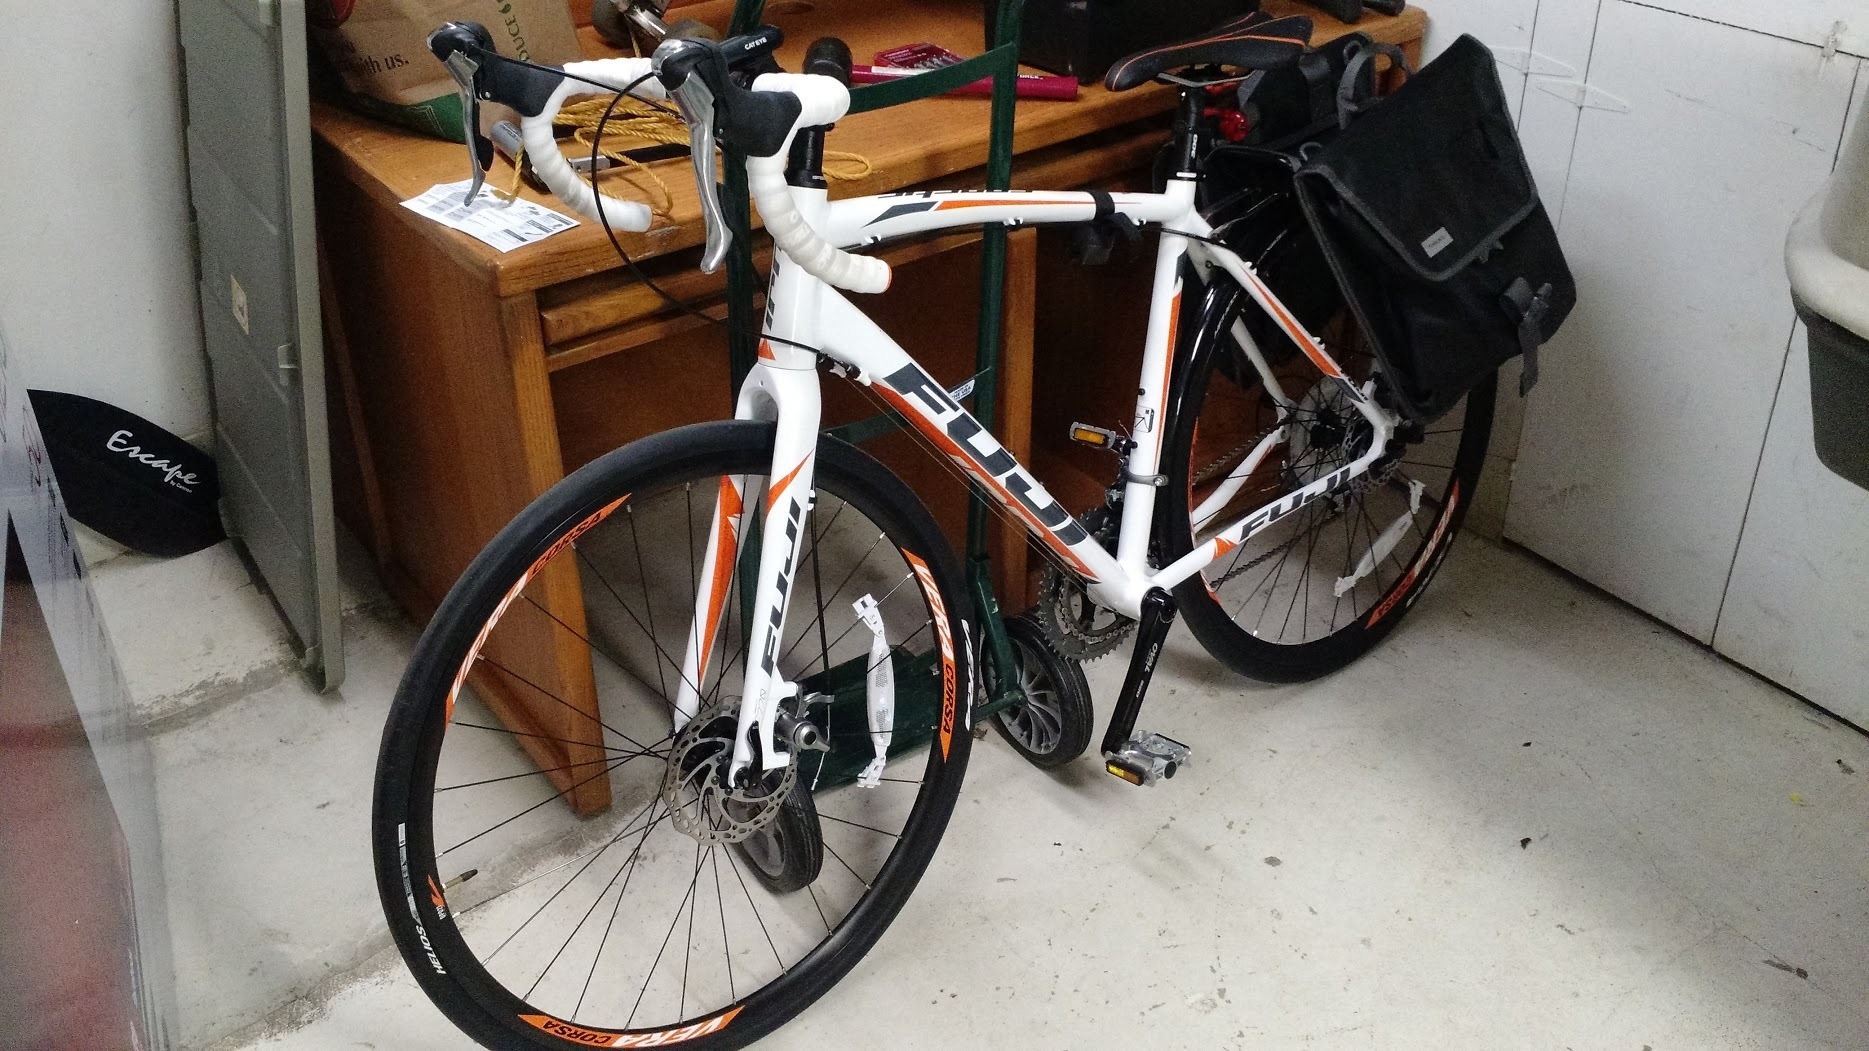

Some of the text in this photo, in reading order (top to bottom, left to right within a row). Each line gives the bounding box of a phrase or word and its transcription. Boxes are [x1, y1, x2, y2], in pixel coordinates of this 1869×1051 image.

[106, 429, 202, 485] Escape
[882, 362, 1089, 547] FUJI
[1239, 466, 1351, 542] FUJI
[761, 496, 801, 678] FUJI
[912, 563, 955, 735] VERA CORSA
[415, 924, 447, 975] HELIOS
[542, 1015, 725, 1048] VERA CORSA
